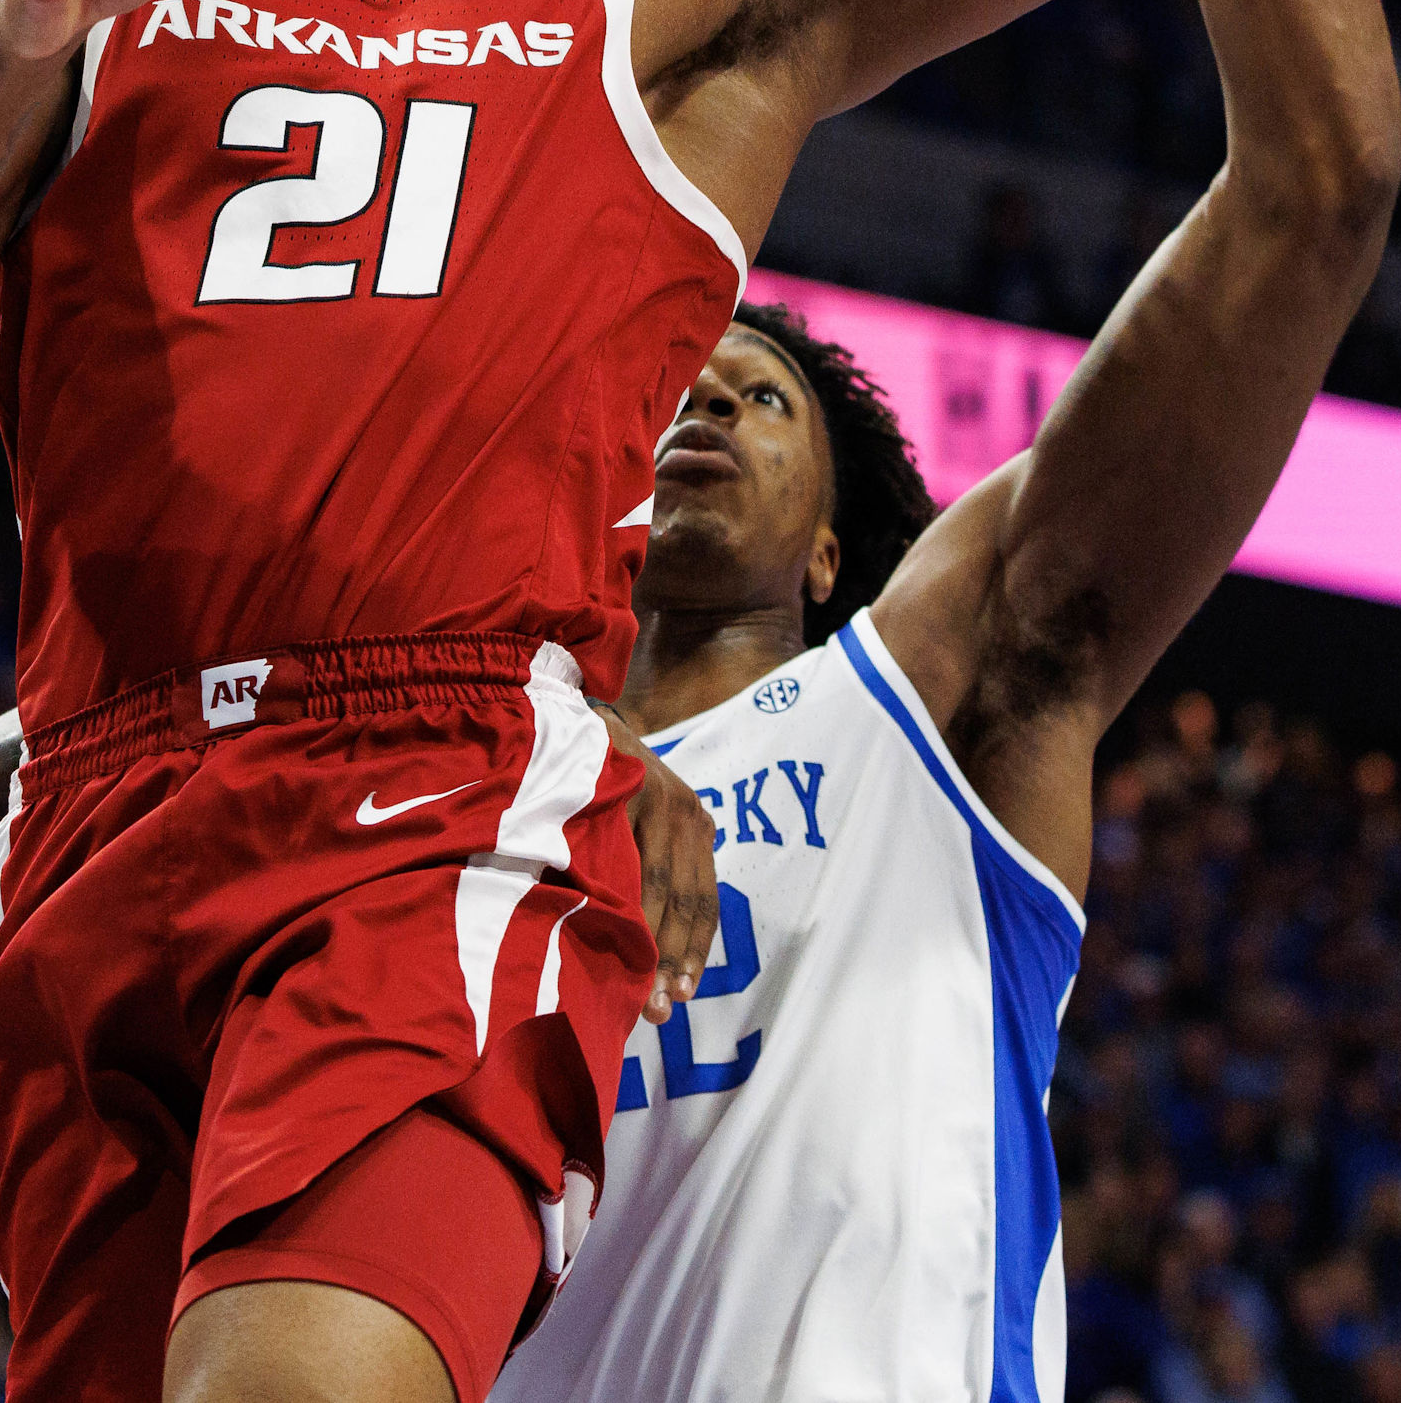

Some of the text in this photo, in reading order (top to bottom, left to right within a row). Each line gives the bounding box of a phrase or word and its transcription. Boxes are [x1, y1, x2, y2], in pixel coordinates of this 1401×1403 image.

[195, 84, 478, 306] 21
[210, 675, 260, 709] AR
[755, 679, 799, 712] SEC
